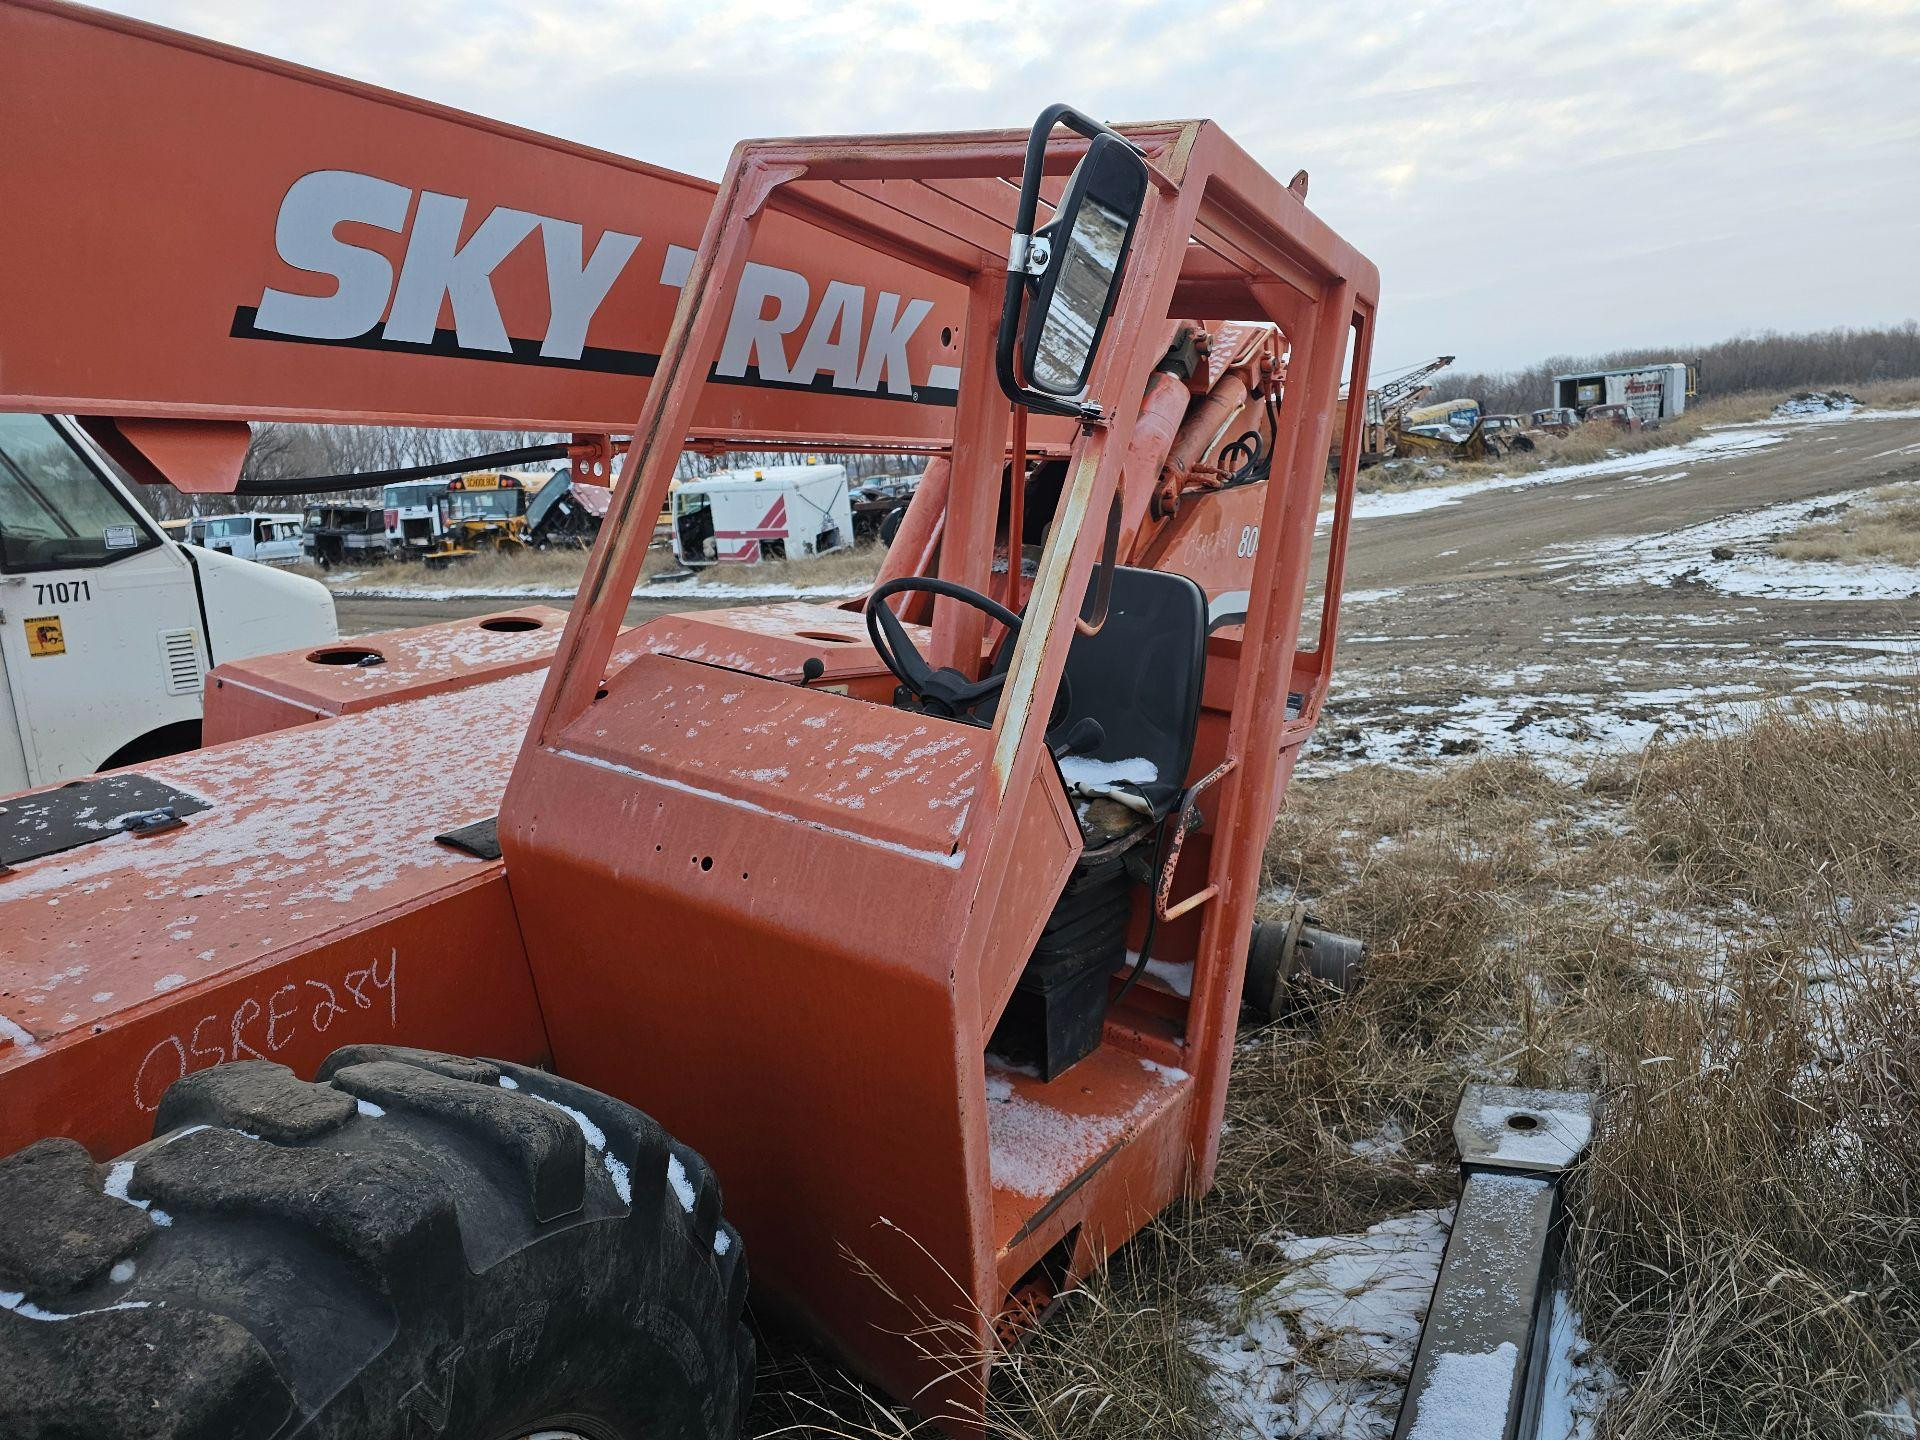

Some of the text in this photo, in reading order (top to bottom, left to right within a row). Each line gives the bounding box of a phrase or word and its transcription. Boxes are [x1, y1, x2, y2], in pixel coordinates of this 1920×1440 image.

[253, 169, 643, 361] SKY
[467, 477, 497, 487] SCHOOL BUS
[1237, 525, 1259, 558] 80
[32, 580, 91, 605] 71071
